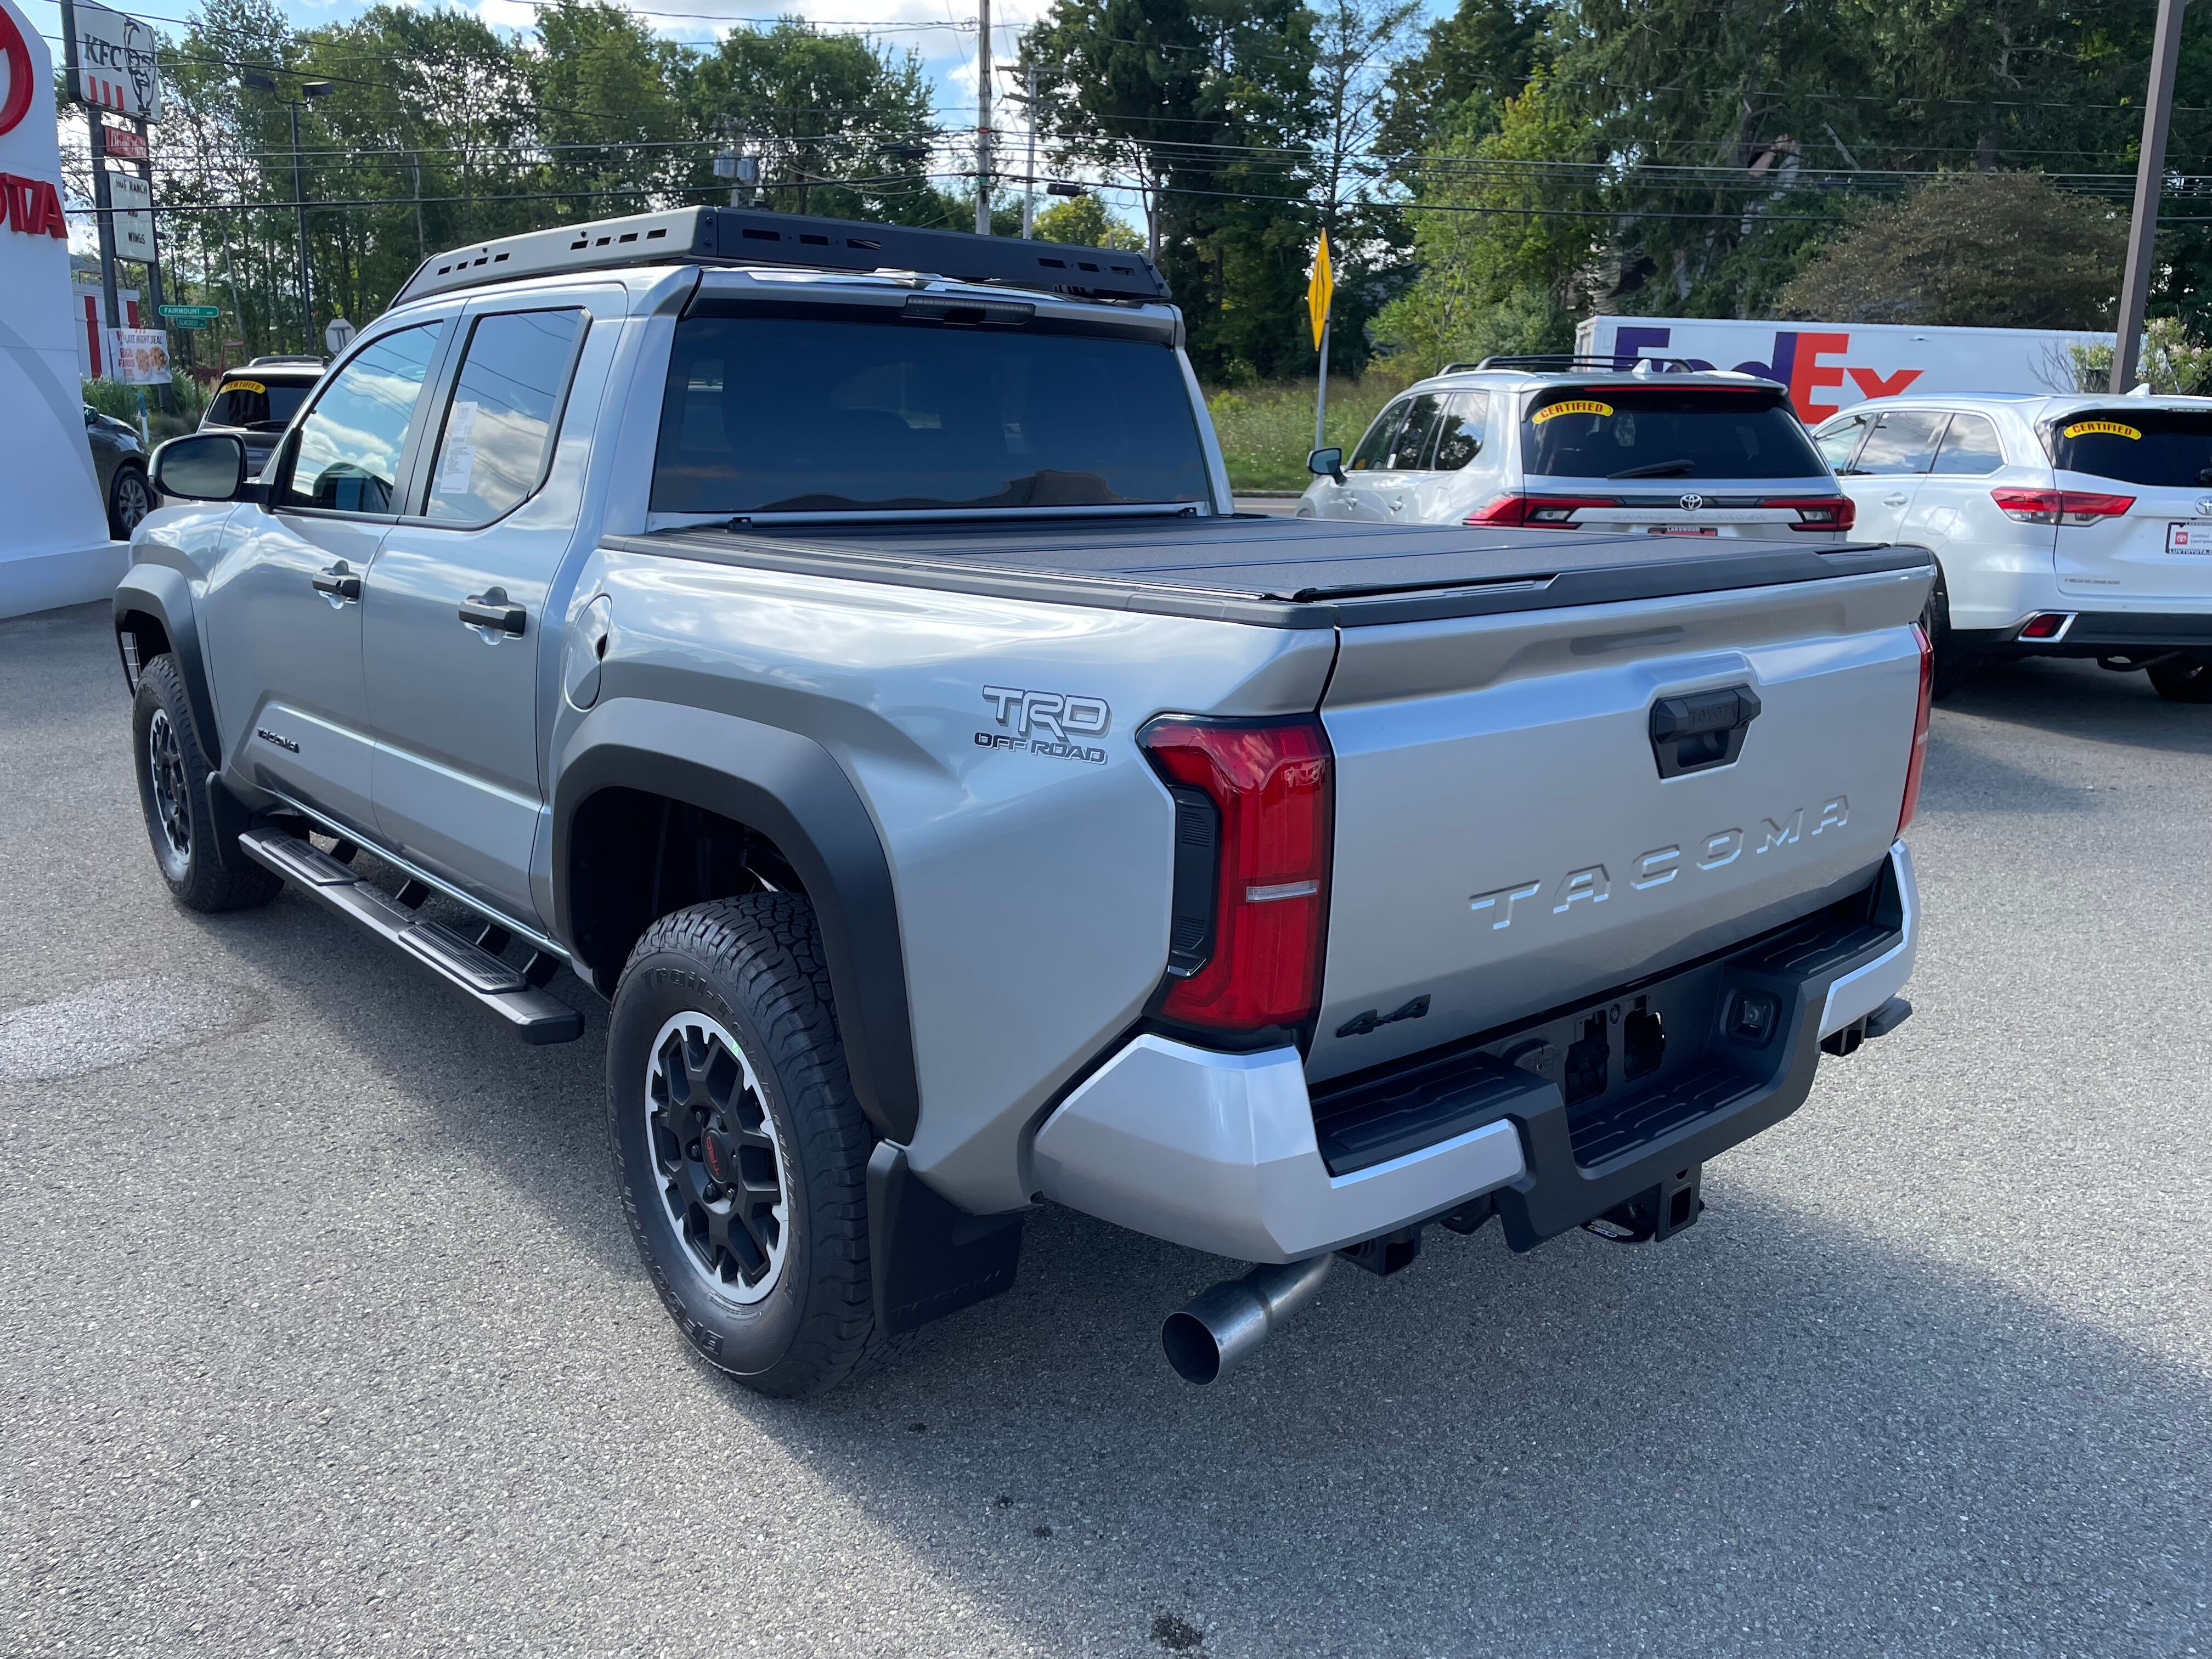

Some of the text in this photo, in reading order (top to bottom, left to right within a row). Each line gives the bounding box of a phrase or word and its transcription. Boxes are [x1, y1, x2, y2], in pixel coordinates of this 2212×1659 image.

[84, 32, 122, 72] KFC
[116, 179, 148, 195] HOT RANCH
[128, 232, 145, 244] WINGS
[125, 334, 136, 344] LATE
[136, 335, 150, 345] NIGHT
[225, 381, 261, 391] CERTIFIED
[1539, 402, 1603, 419] CERTIFIED
[2072, 422, 2132, 436] CERTIFIED
[982, 685, 1112, 743] TRD
[974, 732, 1108, 765] OFF ROAD
[1469, 794, 1849, 930] TACOMA
[706, 1135, 720, 1178] TRD
